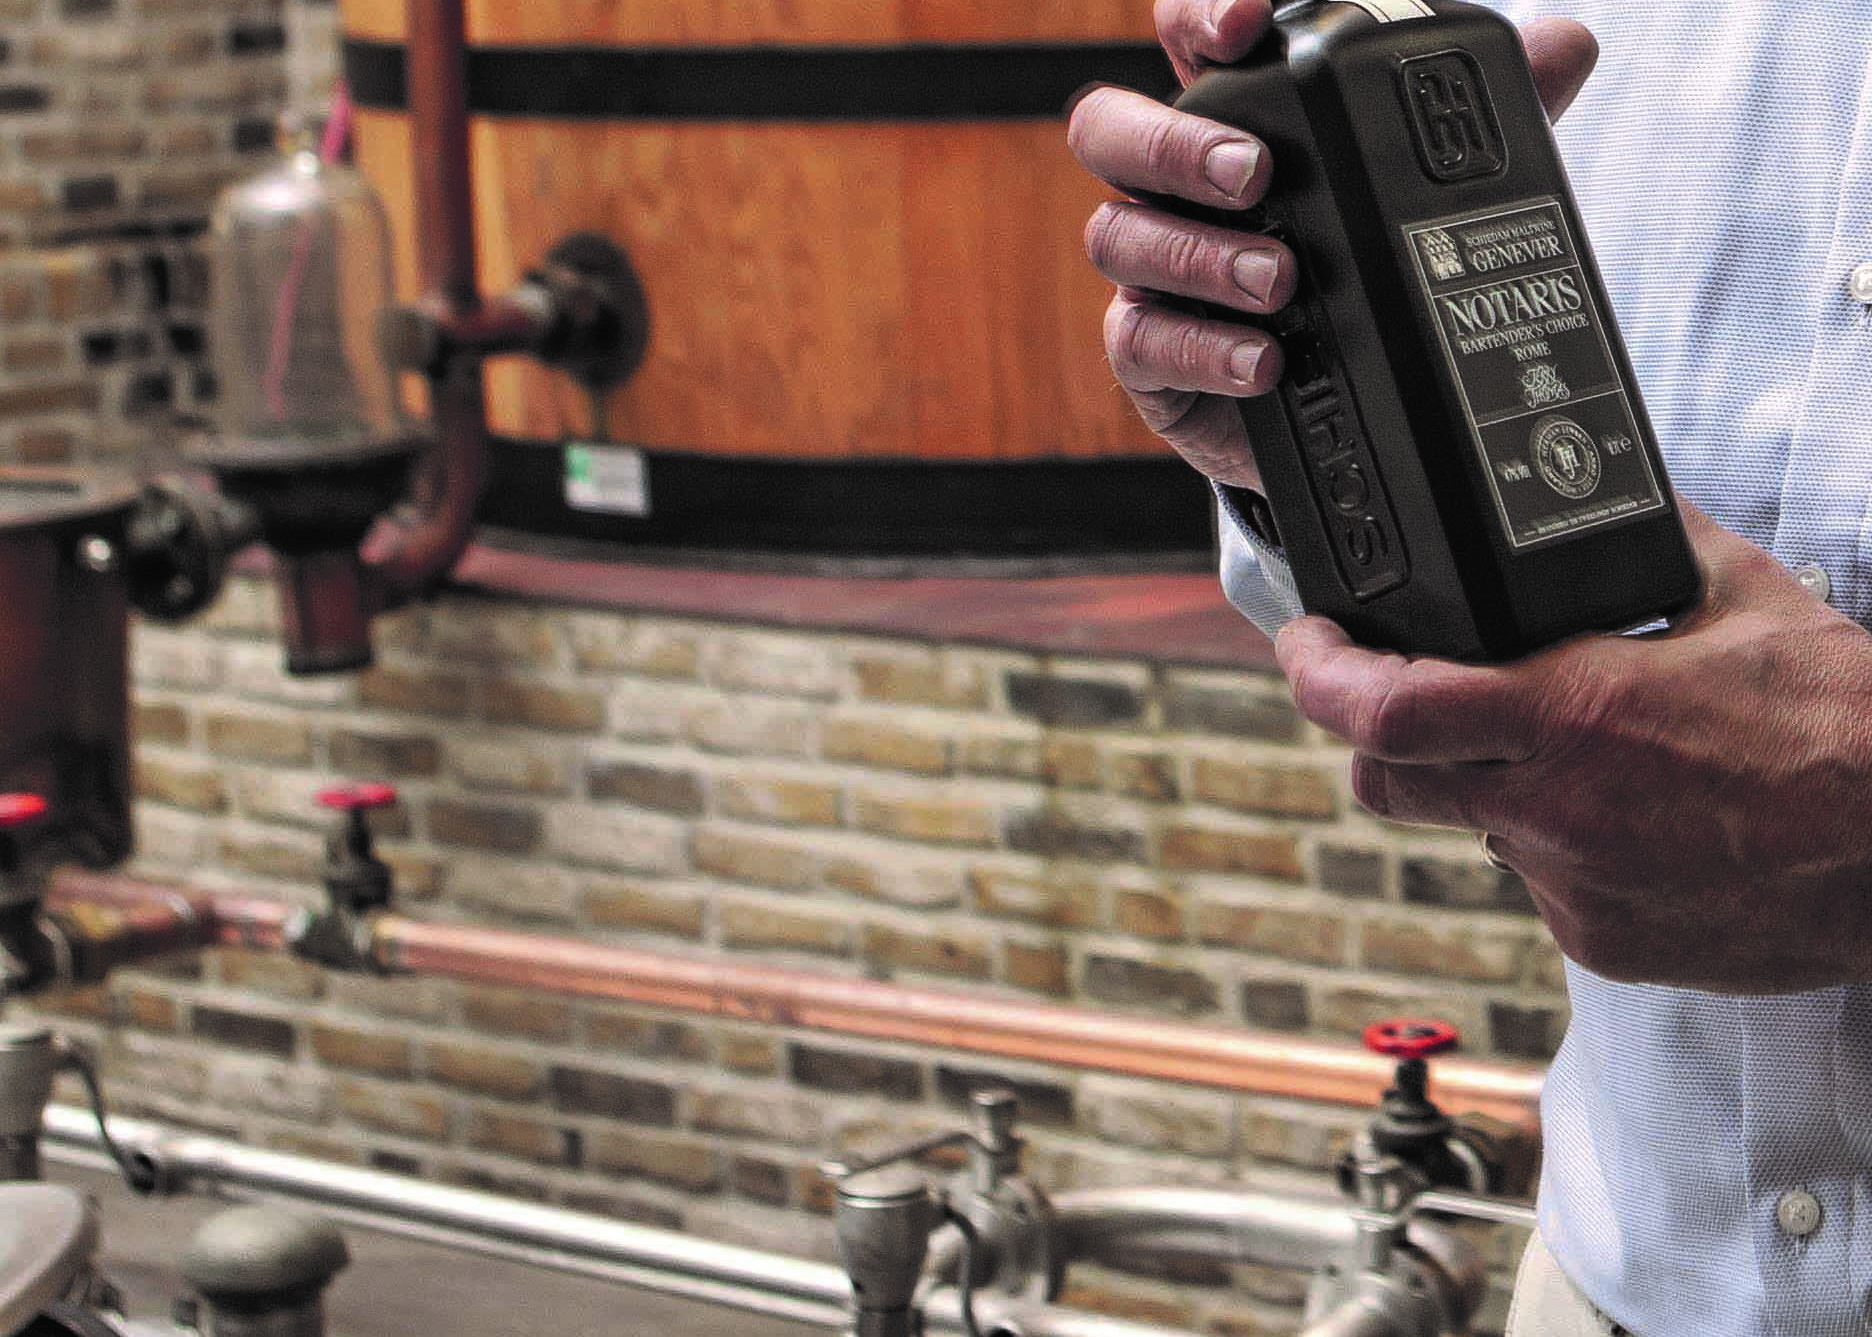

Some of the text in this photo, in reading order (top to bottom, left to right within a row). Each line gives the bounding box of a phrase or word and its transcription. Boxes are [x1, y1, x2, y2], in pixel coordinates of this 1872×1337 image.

[1472, 235, 1564, 272] GENEVER
[1445, 275, 1582, 336] NOTARIS
[1460, 313, 1590, 355] BARTENDER'S CHOICE
[1514, 342, 1552, 363] ROME
